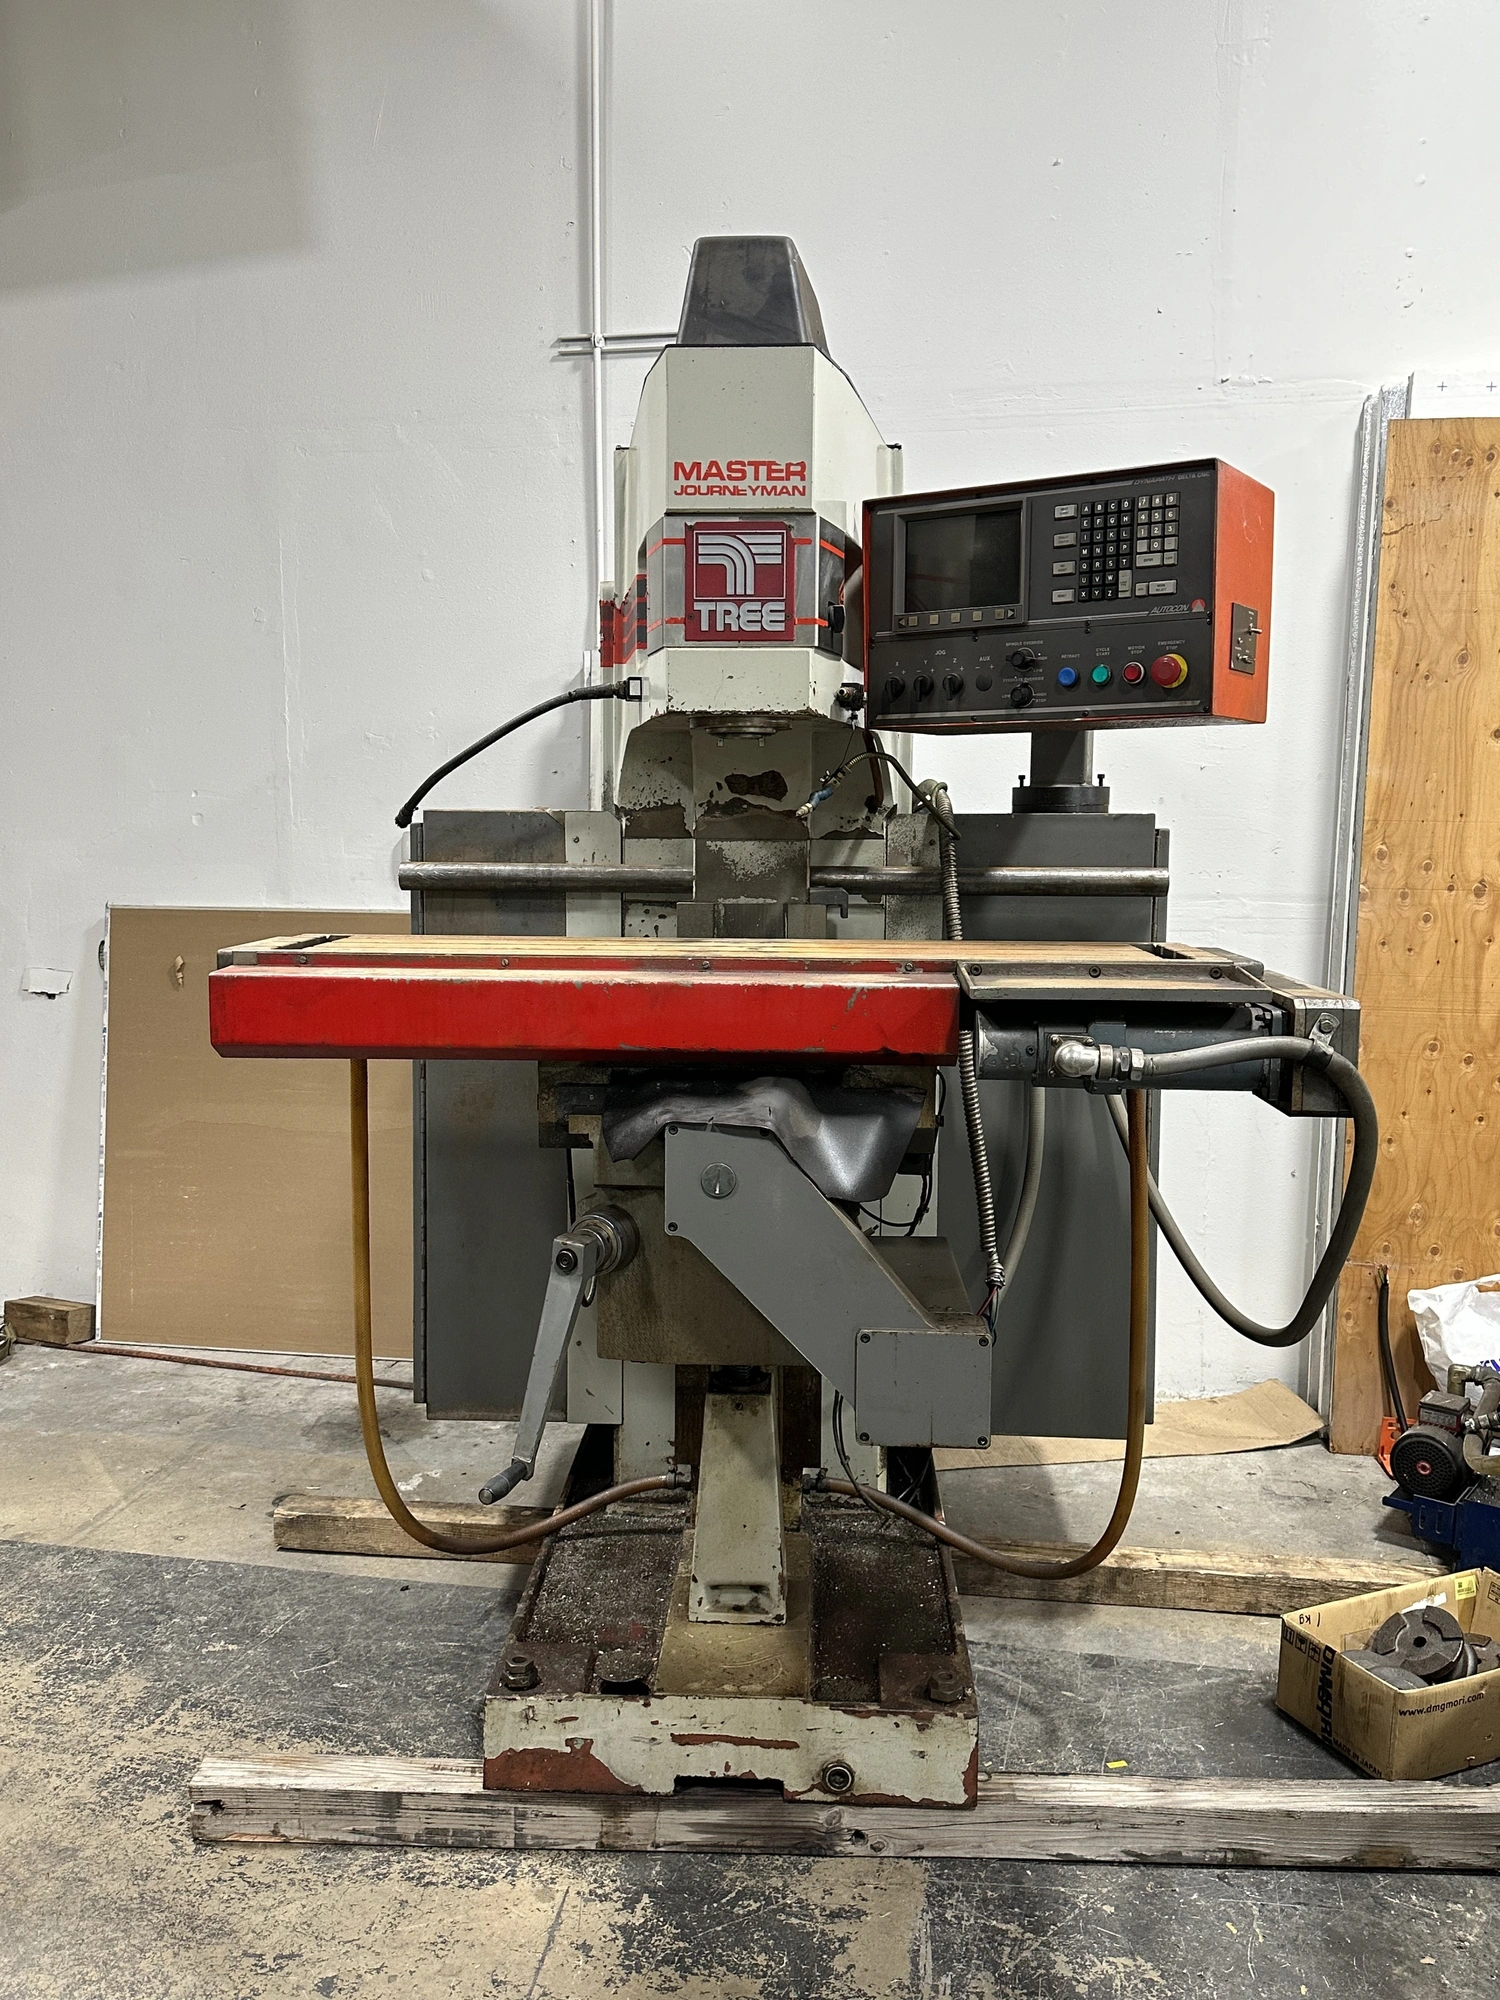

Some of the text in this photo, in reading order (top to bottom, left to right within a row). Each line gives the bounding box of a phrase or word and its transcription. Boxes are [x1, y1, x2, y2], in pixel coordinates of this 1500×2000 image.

[673, 460, 807, 482] MASTER
[1177, 472, 1197, 480] DELTA
[673, 484, 807, 497] JOURNEYMAN
[693, 601, 786, 632] TREE
[1150, 604, 1190, 613] AUTOCON
[1398, 1692, 1484, 1717] www.dmgmori.com
[1333, 1738, 1382, 1778] MADE IN JAPAN
